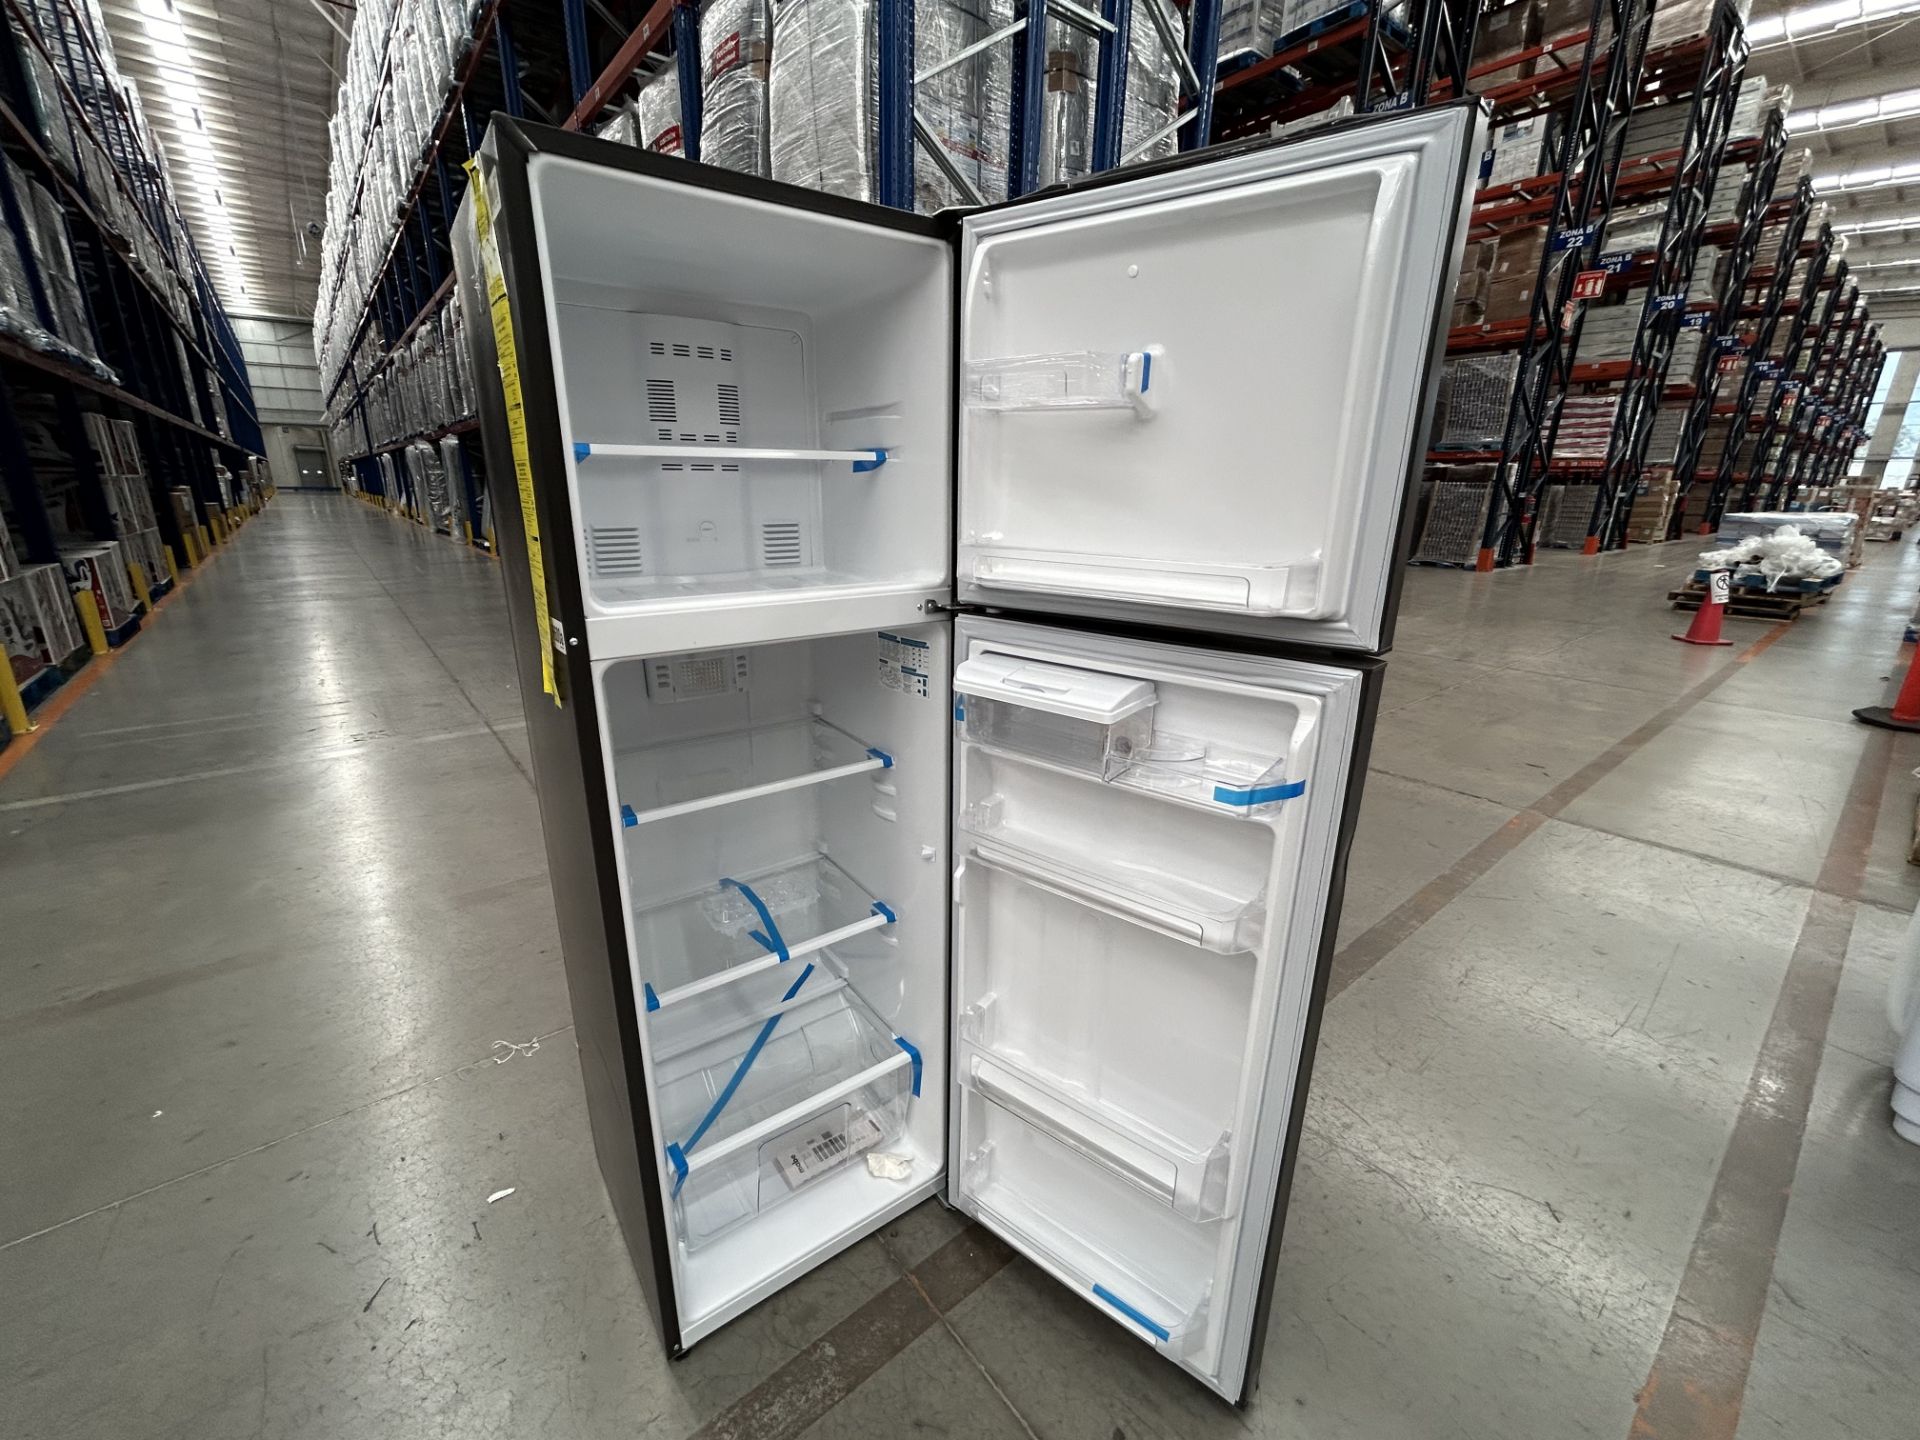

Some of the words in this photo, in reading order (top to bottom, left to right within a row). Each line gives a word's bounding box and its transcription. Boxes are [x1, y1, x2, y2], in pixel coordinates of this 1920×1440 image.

[1373, 99, 1397, 113] ZONA
[1400, 92, 1408, 103] B
[1484, 151, 1492, 160] B
[1560, 228, 1583, 239] ZONA
[1586, 225, 1594, 234] B
[1566, 236, 1584, 248] 22
[1600, 257, 1623, 265] ZONA
[1625, 253, 1632, 261] B
[1607, 263, 1622, 273] 21
[1656, 294, 1676, 302] ZONA
[1660, 301, 1675, 310] 20
[1689, 318, 1703, 326] 19
[790, 1154, 805, 1173] mabe
